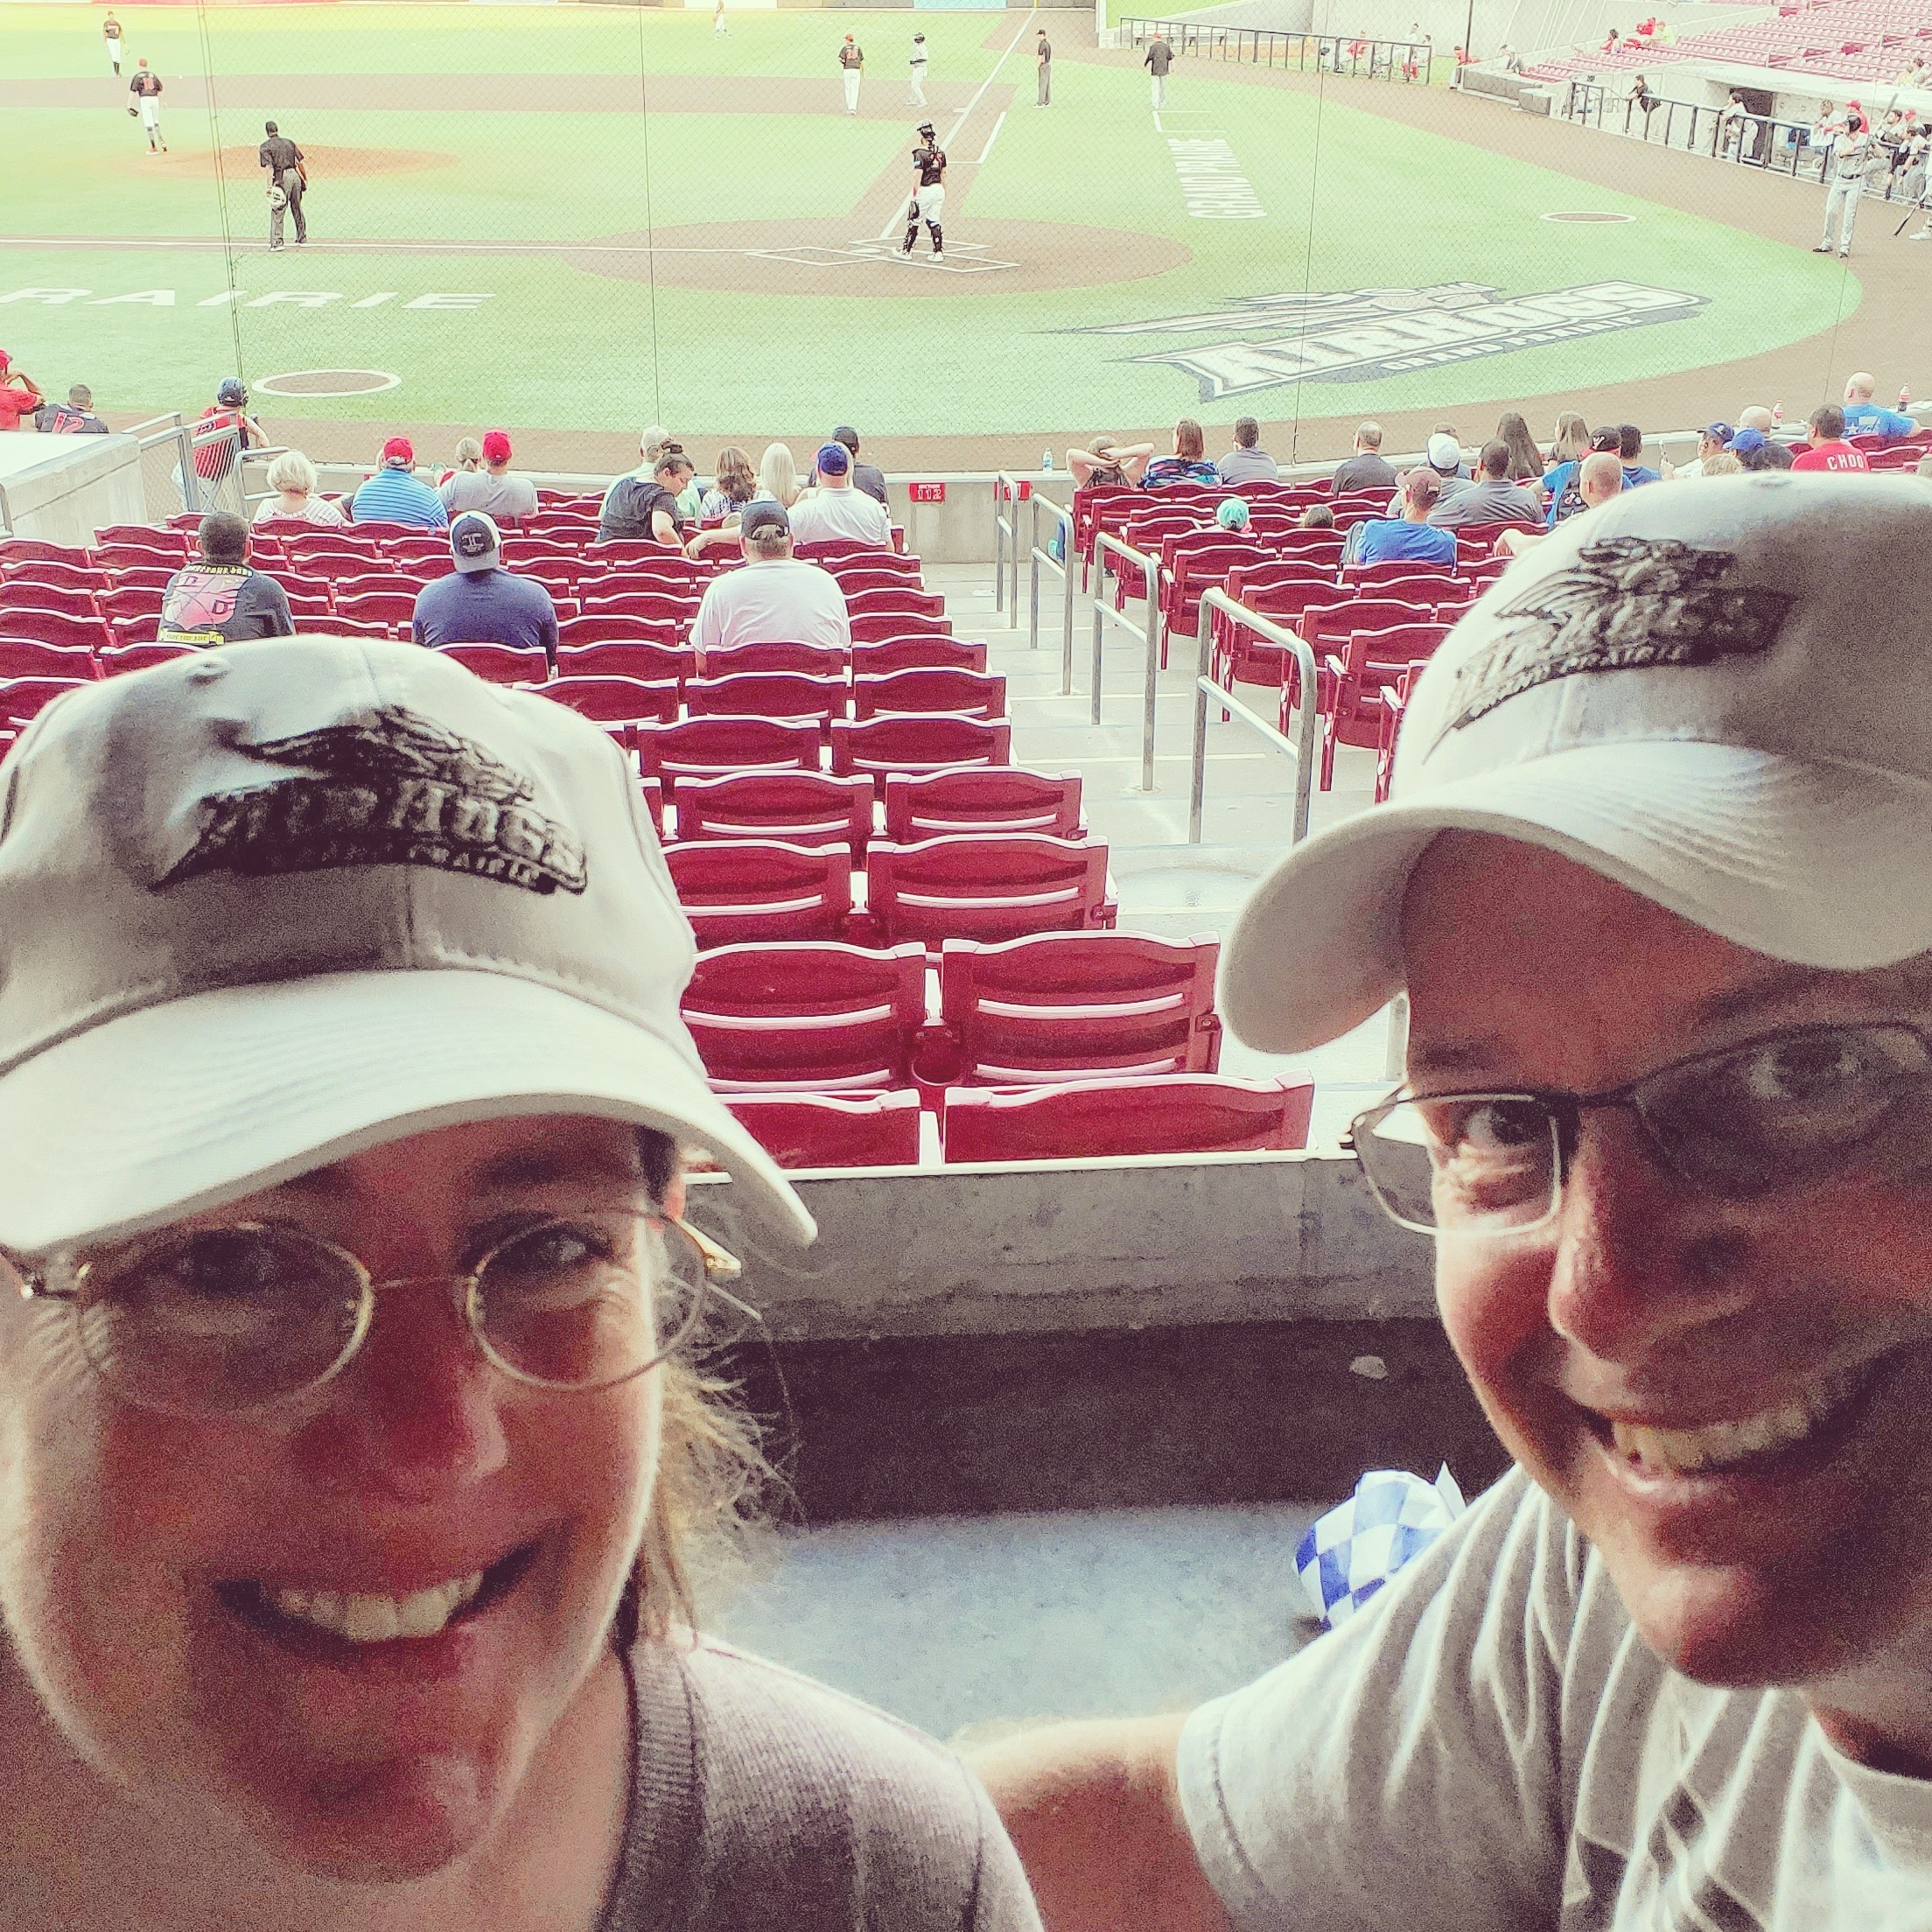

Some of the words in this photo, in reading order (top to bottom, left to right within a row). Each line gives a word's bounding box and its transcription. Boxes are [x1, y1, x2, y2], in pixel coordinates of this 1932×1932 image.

[1166, 138, 1244, 174] PRAIRIE
[1179, 176, 1268, 219] GRAND
[1174, 281, 1687, 394] AIRHOGS
[1379, 343, 1504, 370] GRAND
[1500, 316, 1643, 346] PRAIRIE
[1826, 453, 1865, 471] CHOO
[917, 489, 942, 500] 112
